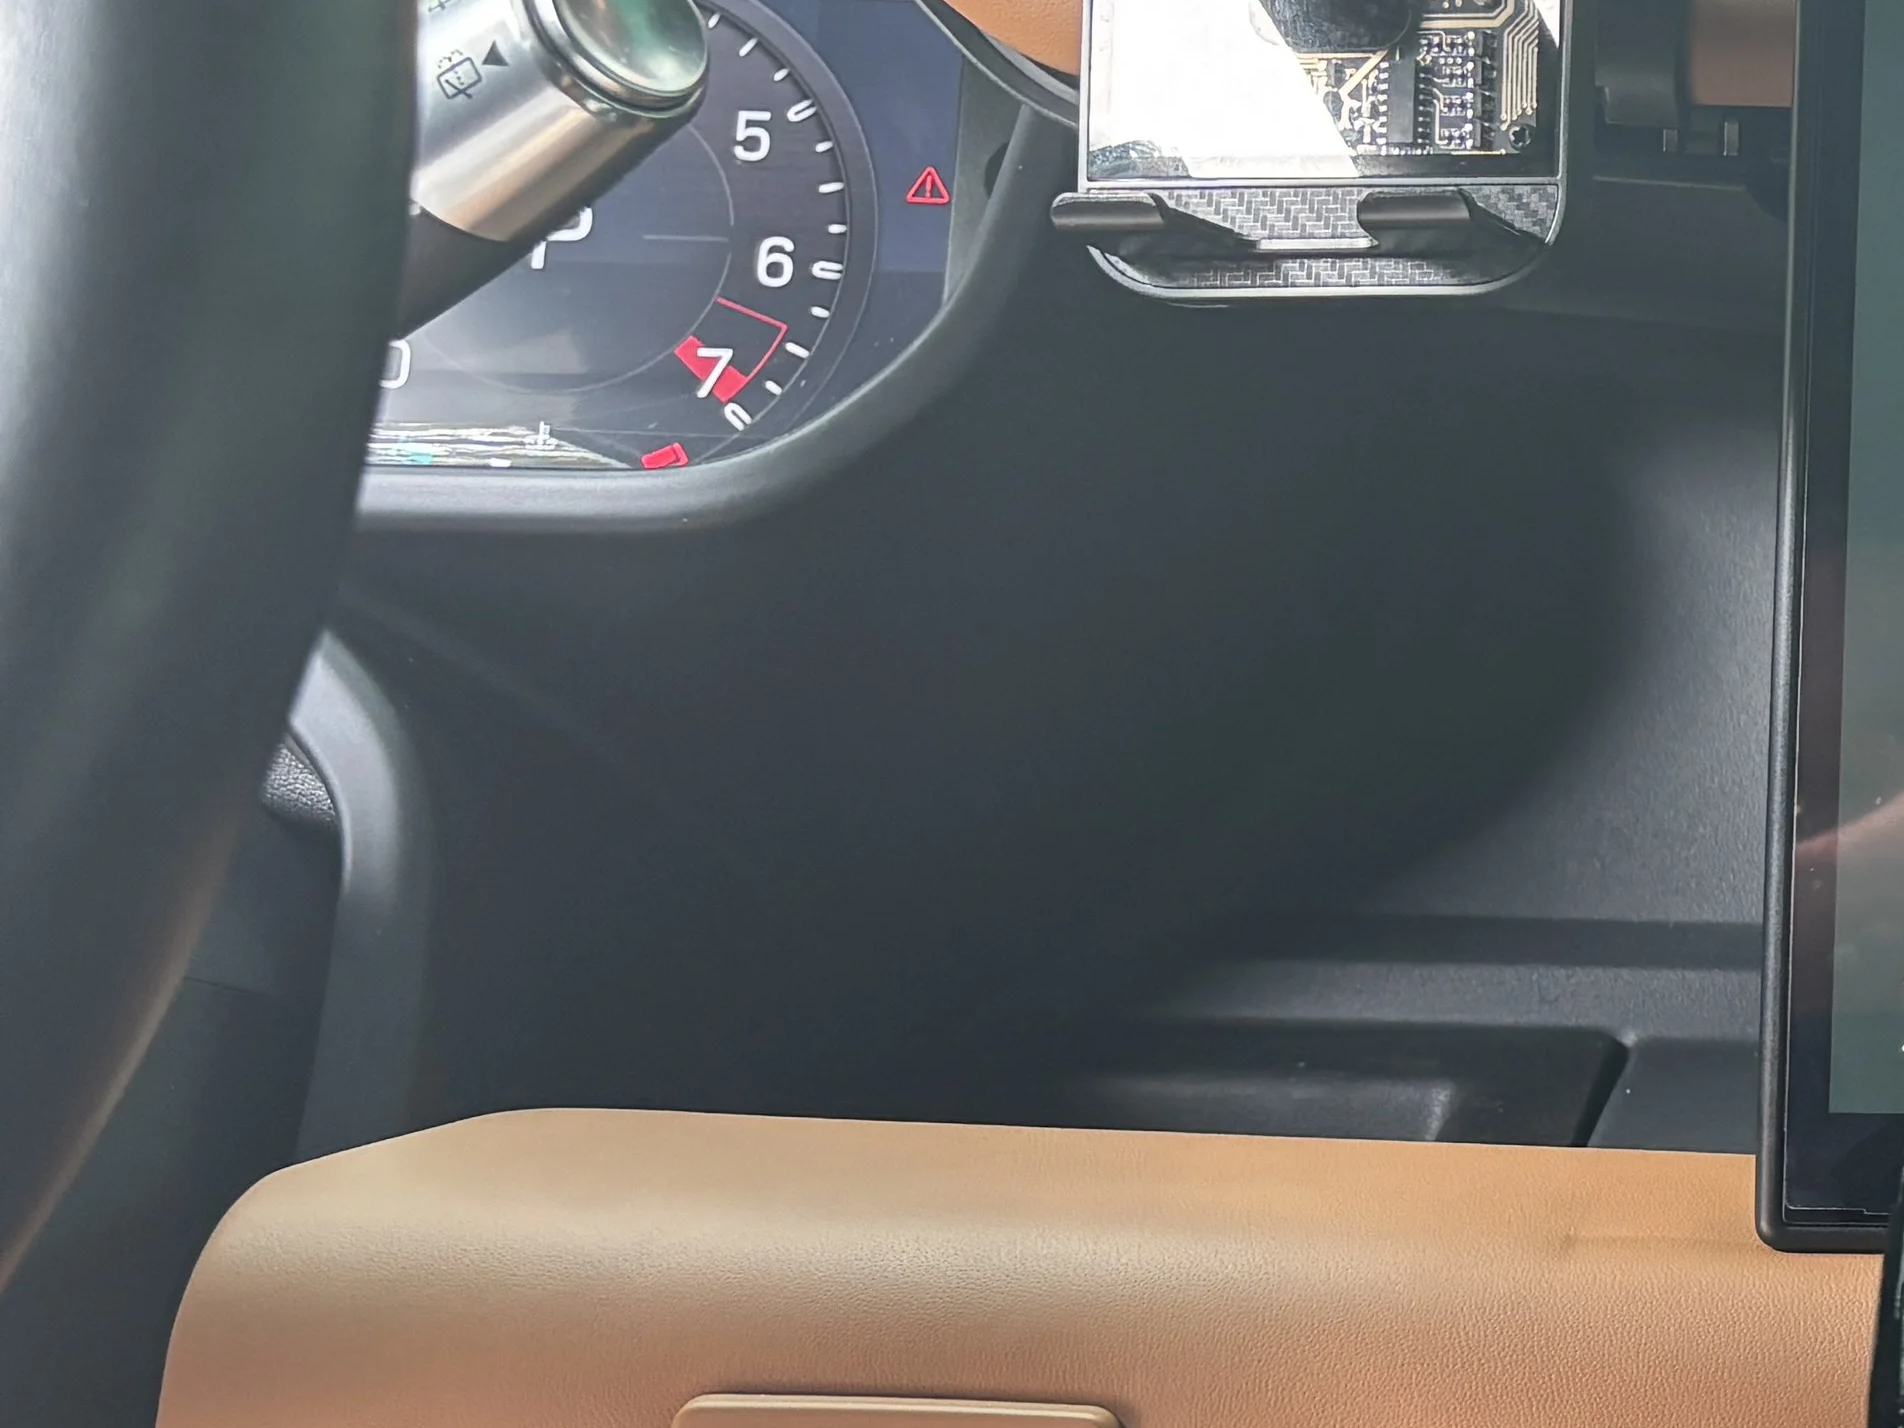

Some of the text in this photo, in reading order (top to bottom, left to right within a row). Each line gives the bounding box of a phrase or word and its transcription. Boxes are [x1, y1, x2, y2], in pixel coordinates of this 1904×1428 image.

[733, 110, 772, 162] 5
[756, 236, 795, 288] 6
[697, 347, 734, 398] 7
